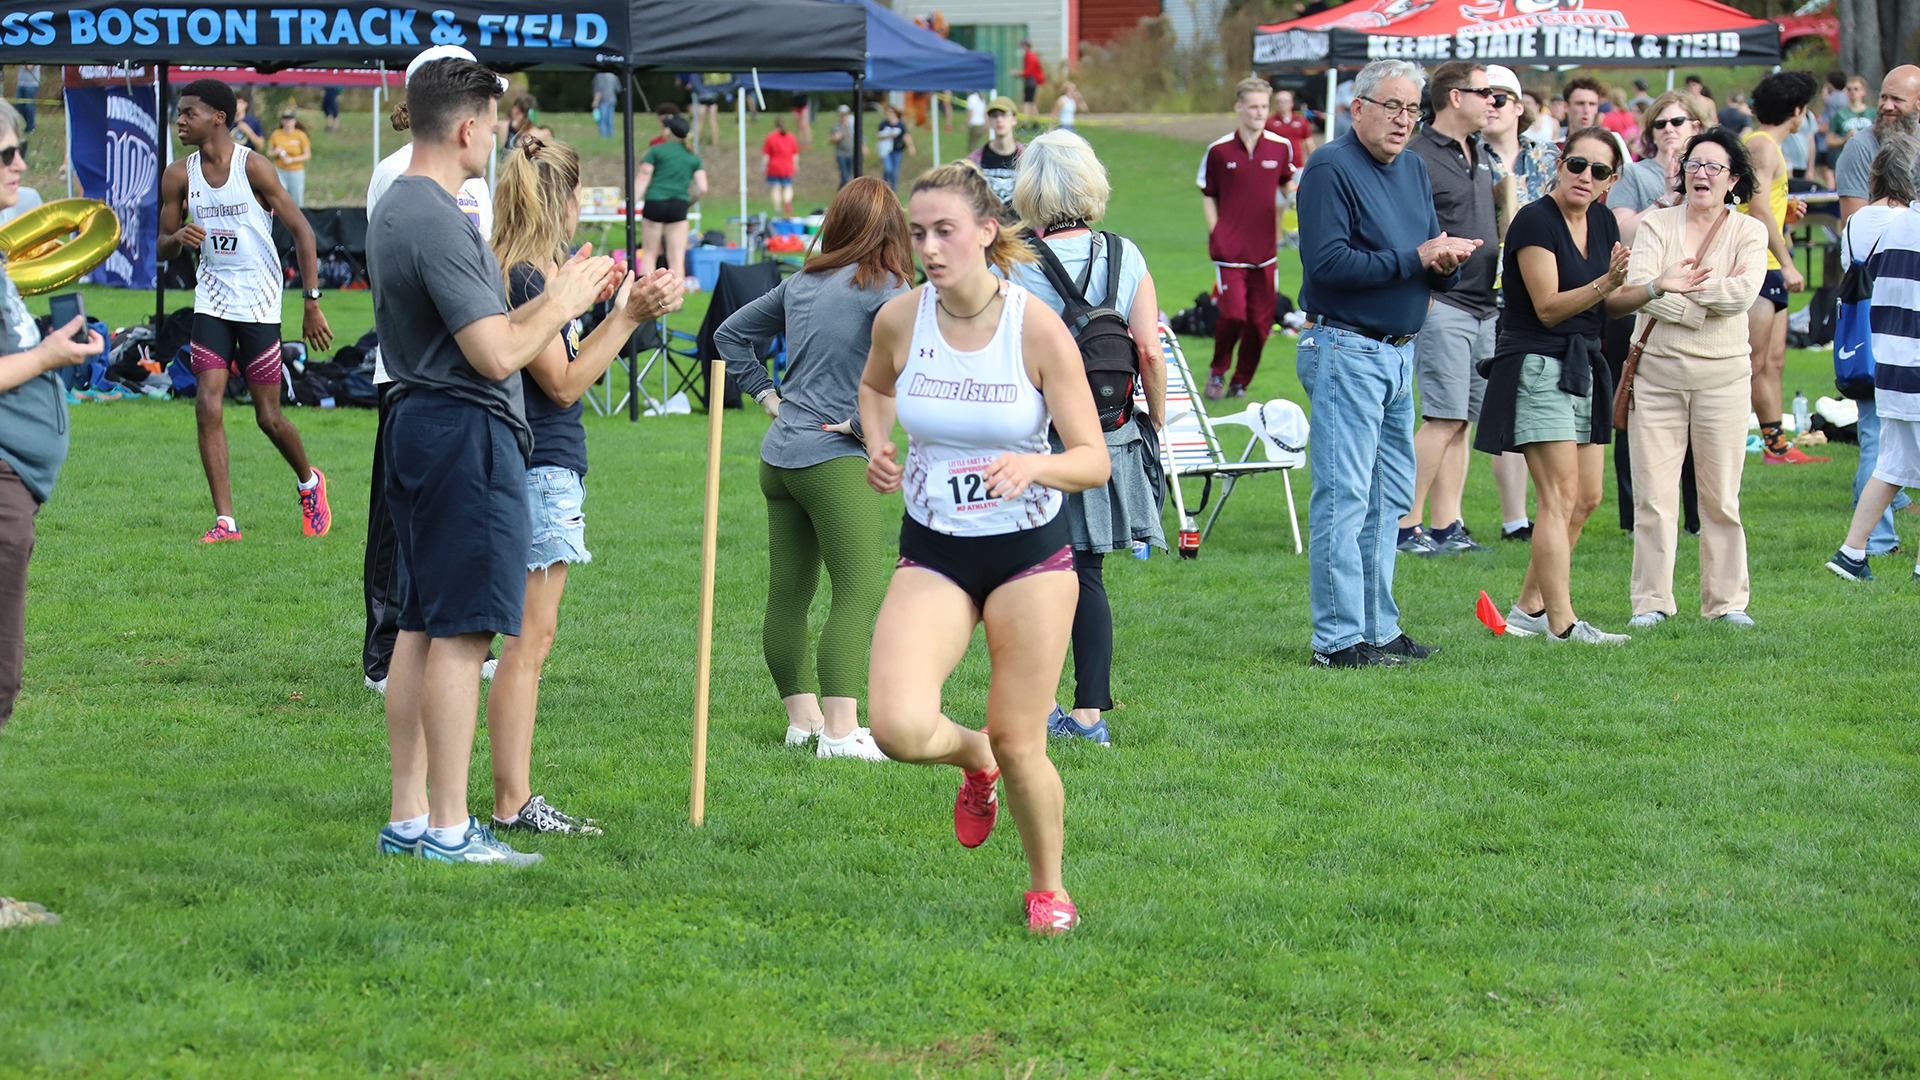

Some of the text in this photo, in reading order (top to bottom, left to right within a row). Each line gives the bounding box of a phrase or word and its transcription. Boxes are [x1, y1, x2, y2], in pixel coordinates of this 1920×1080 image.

[0, 7, 608, 48] SS BOSTON TRACK & FIELD
[1367, 26, 1741, 60] KEENE STATE TRACK & FIELD
[196, 202, 248, 219] RHODE ISLAND
[1049, 219, 1077, 232] Canon
[210, 235, 238, 251] 127
[908, 372, 1018, 403] RHODE ISLAND
[967, 457, 981, 465] EAST
[967, 501, 999, 511] ATHLETIC
[1313, 652, 1330, 665] HOKA
